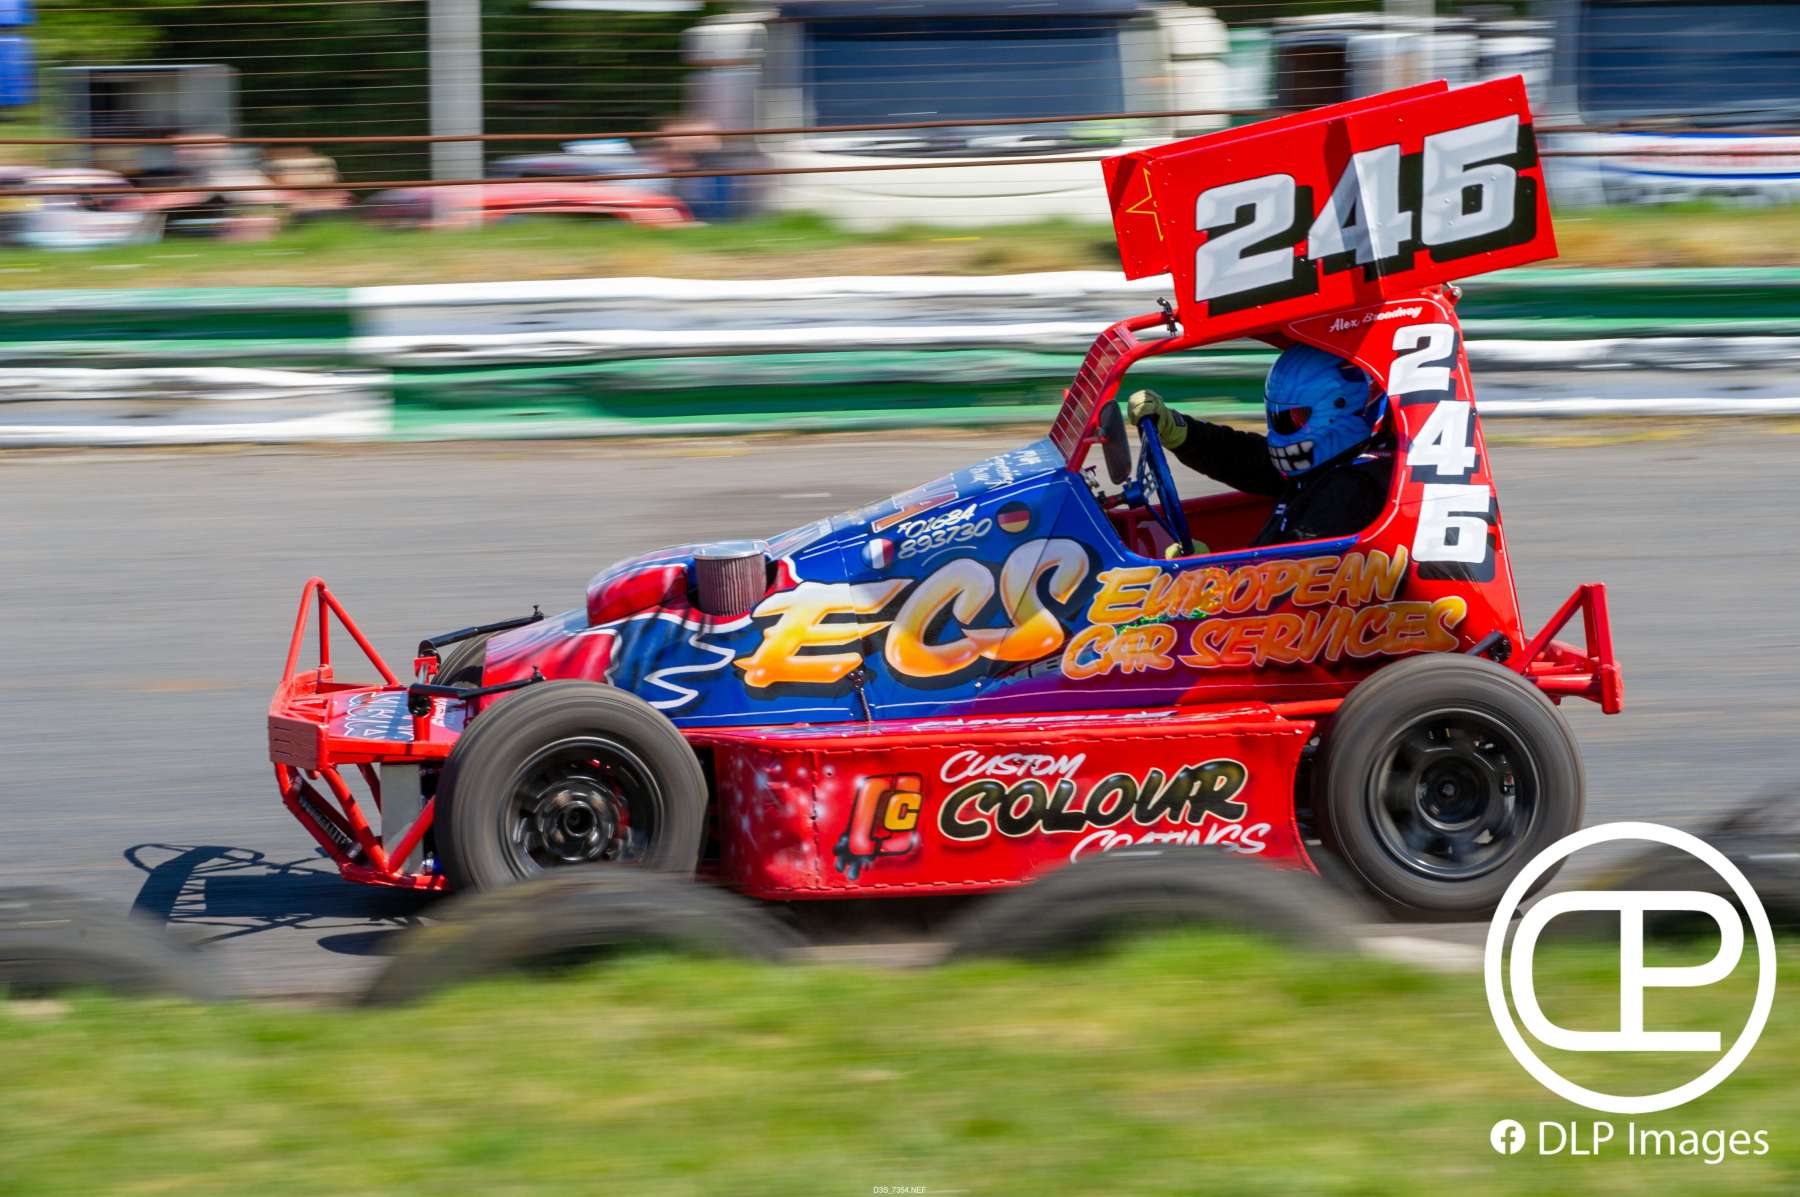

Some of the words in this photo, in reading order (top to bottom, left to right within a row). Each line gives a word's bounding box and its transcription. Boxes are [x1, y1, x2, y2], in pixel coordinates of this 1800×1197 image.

[1194, 114, 1521, 303] 246
[1328, 318, 1360, 333] Alex
[1387, 322, 1491, 565] 246
[897, 517, 993, 560] 893730
[733, 538, 1091, 688] ECS
[1087, 544, 1408, 626] EUROPEAN
[1061, 624, 1178, 681] CAR
[1178, 596, 1467, 668] SERVICES
[938, 758, 1248, 842] COLOUR
[939, 750, 1087, 783] CUSTOM
